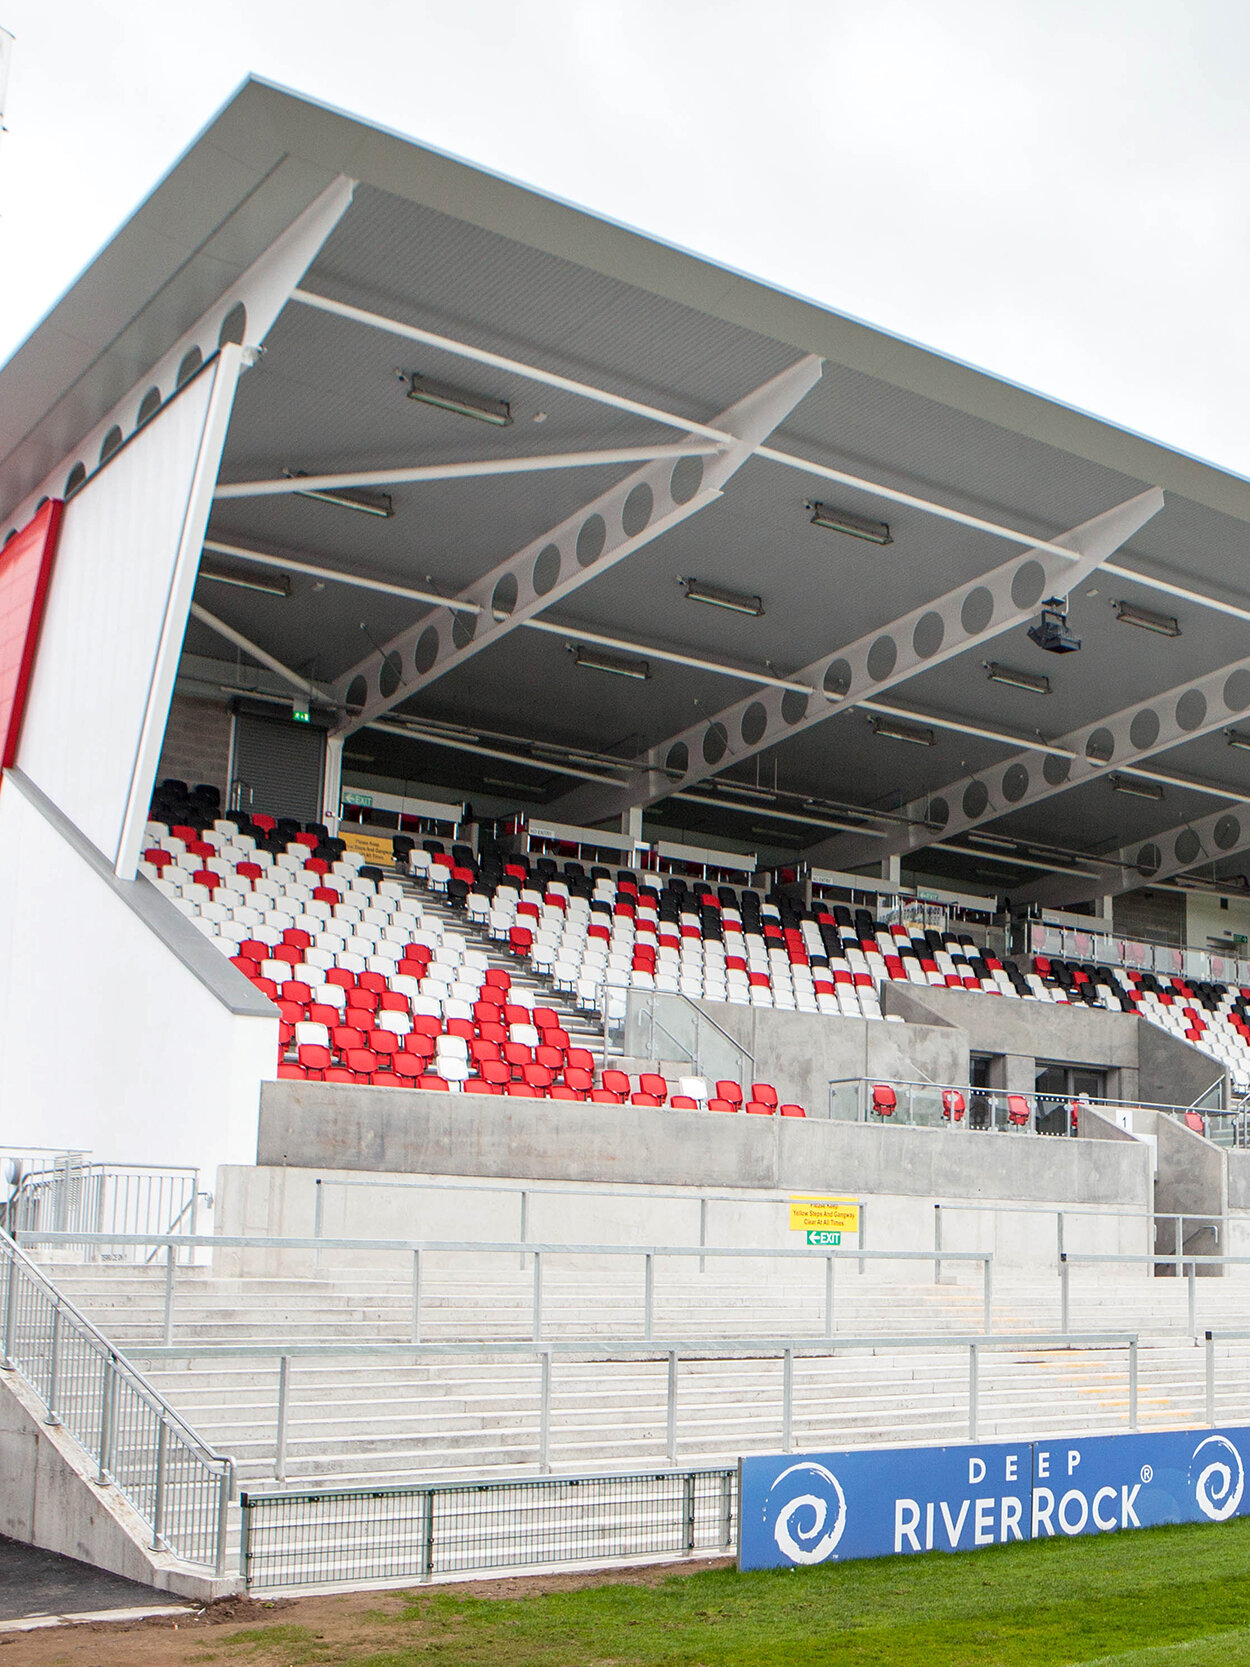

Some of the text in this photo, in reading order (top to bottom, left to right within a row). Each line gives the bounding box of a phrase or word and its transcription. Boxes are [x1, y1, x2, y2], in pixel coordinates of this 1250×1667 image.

[809, 1210, 822, 1218] Steps
[823, 1210, 833, 1218] And
[833, 1211, 856, 1220] Gangway
[830, 1219, 845, 1227] Times
[820, 1232, 841, 1244] EXIT
[969, 1450, 1081, 1485] DEEP
